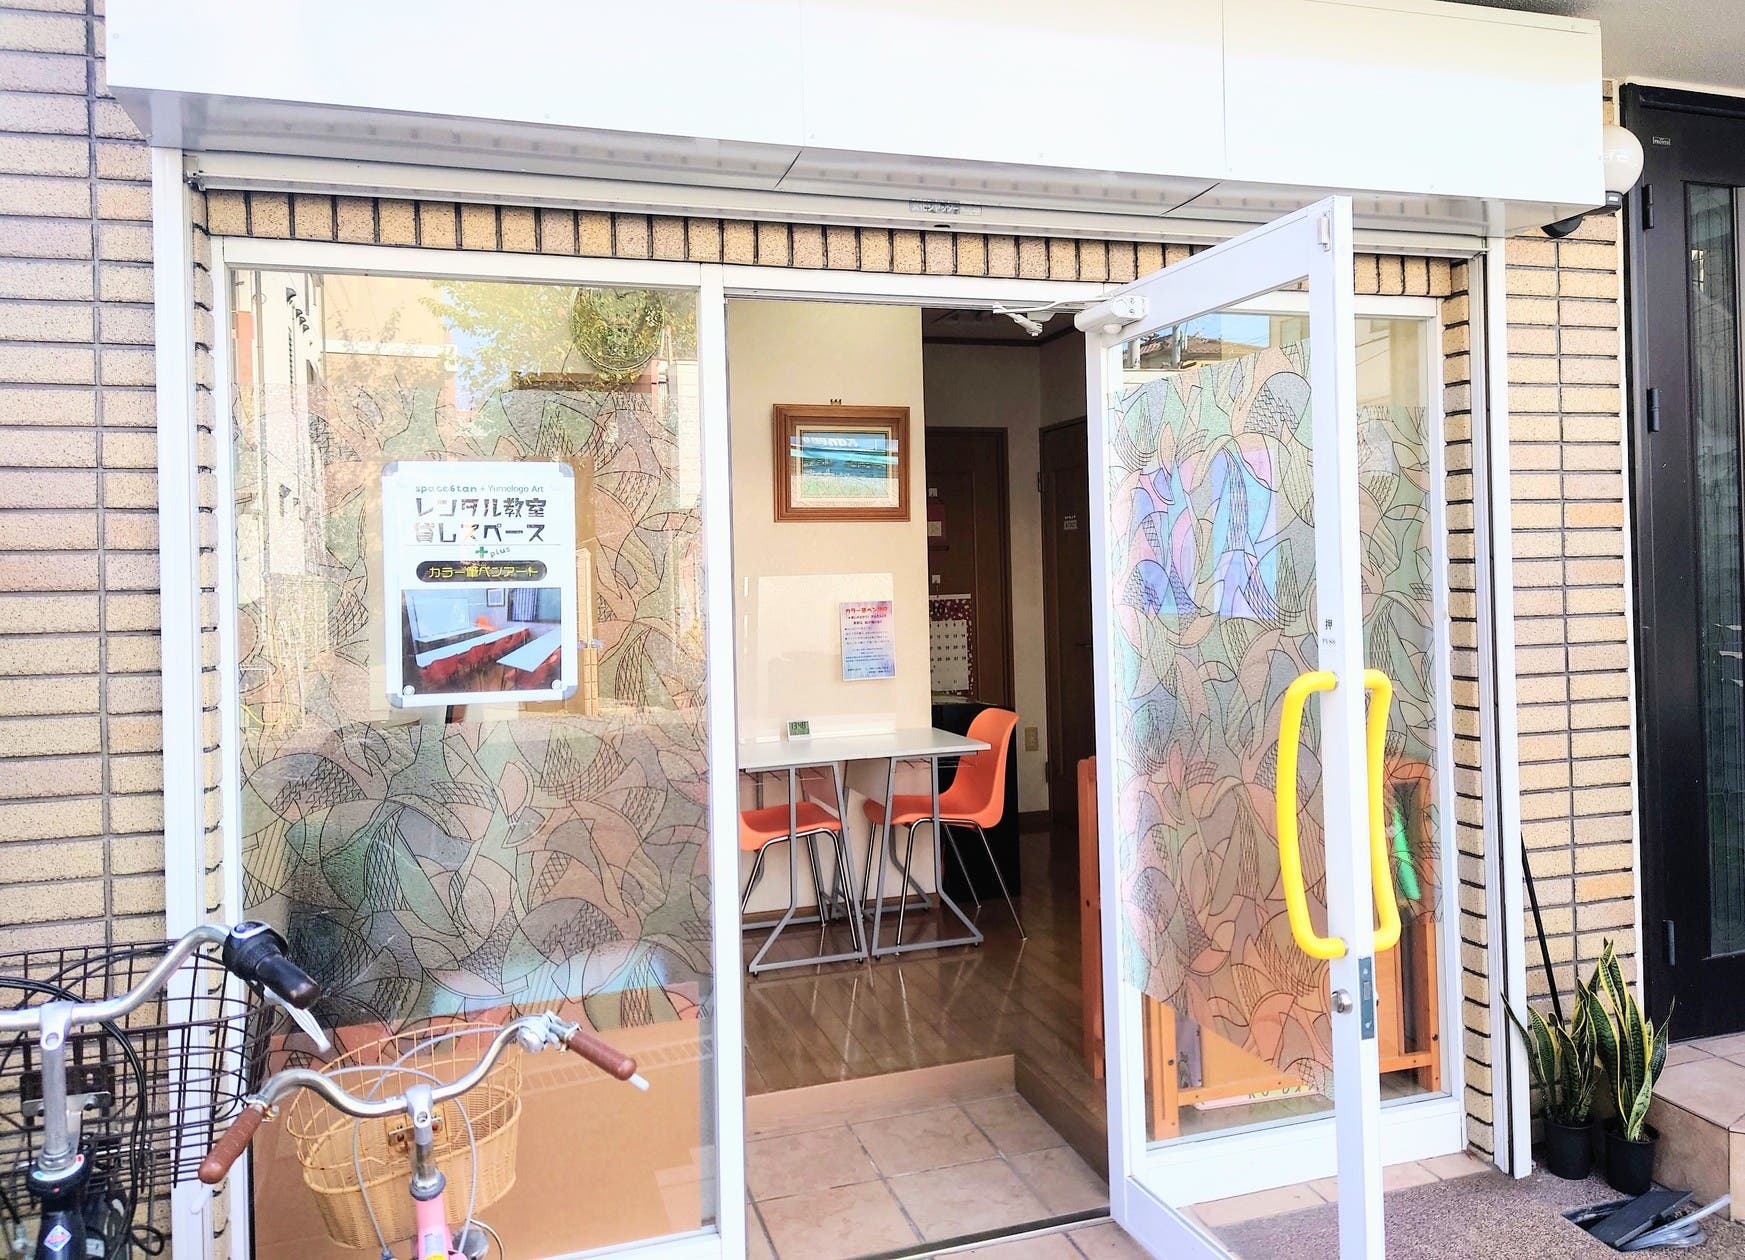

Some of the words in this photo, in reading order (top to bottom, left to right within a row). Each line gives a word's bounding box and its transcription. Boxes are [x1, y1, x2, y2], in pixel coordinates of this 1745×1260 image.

[531, 485, 544, 493] Art
[415, 498, 547, 518] レンタル教室
[490, 546, 511, 558] plus
